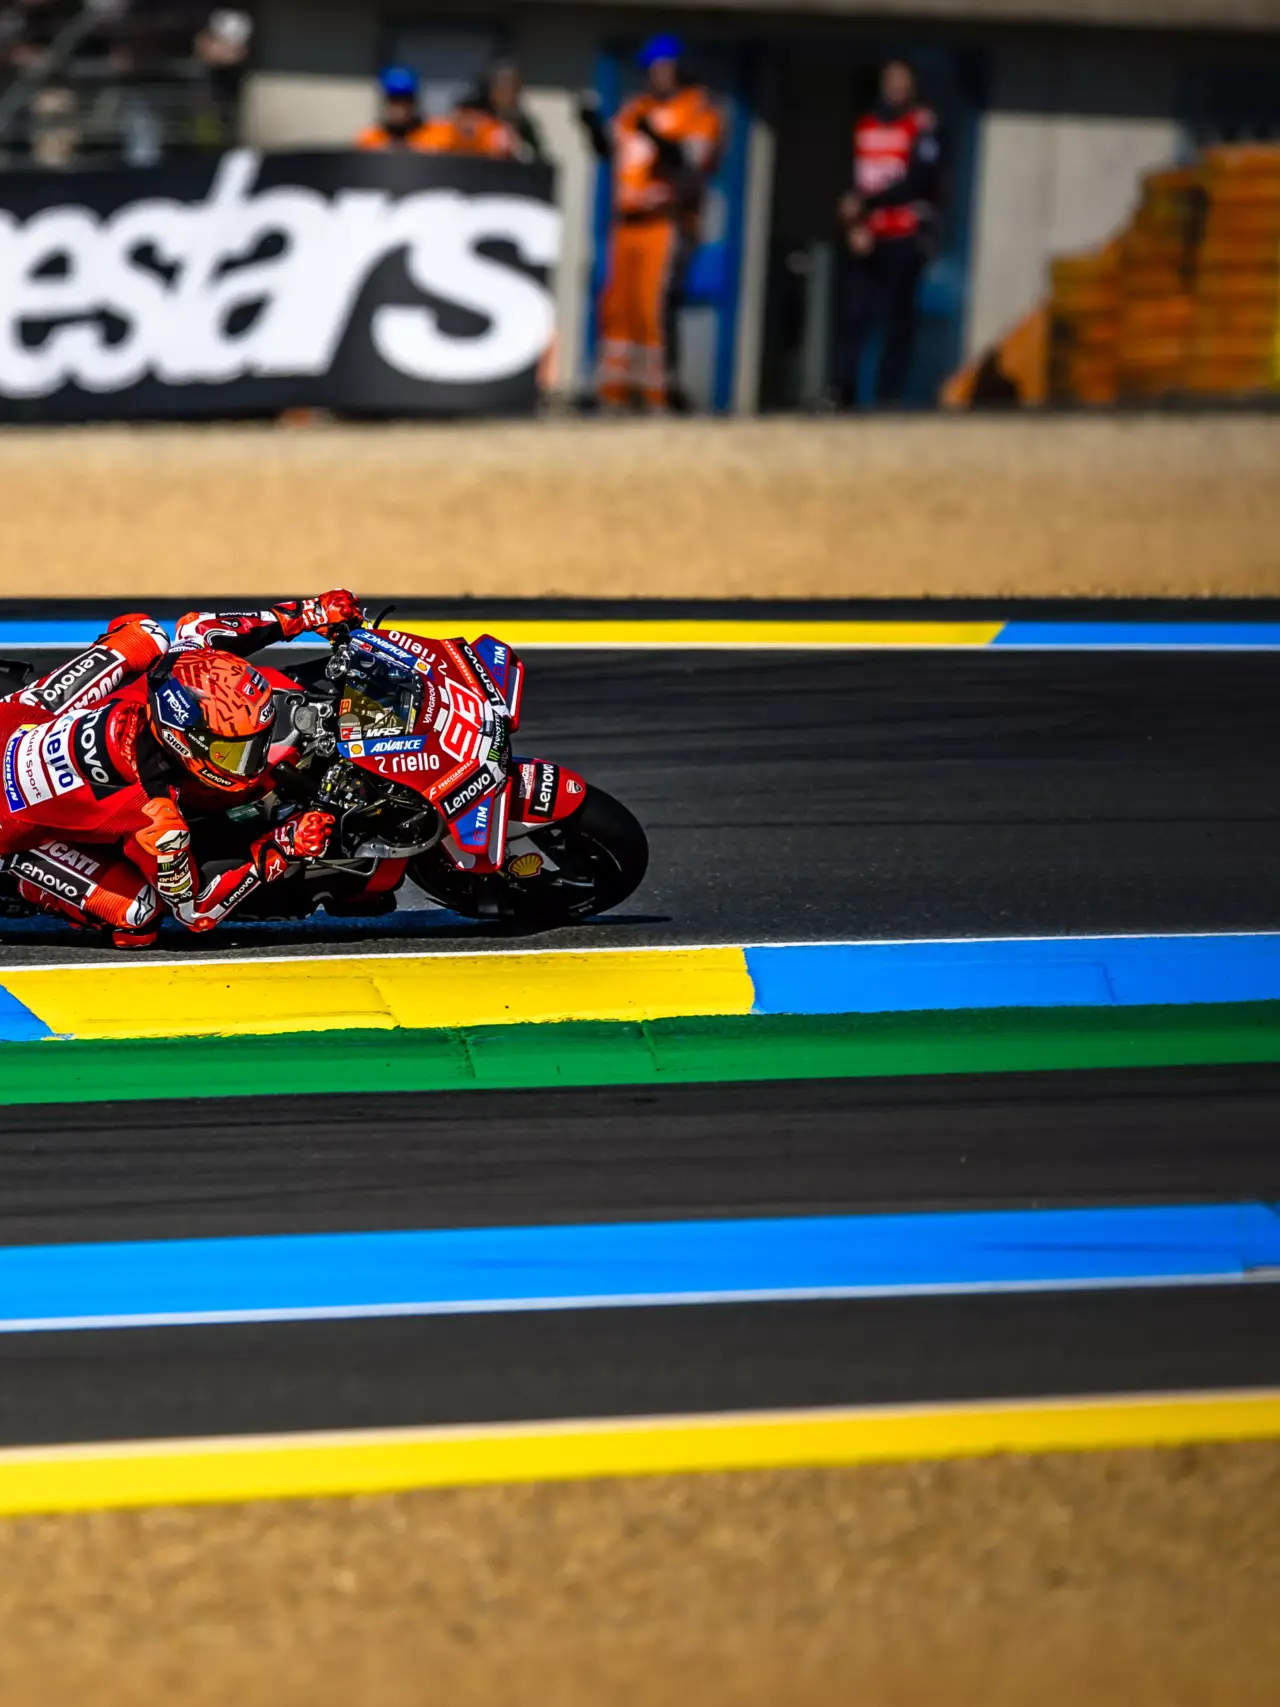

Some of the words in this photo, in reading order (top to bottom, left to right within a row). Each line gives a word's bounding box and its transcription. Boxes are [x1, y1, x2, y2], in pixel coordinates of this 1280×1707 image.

[388, 630, 437, 663] riello
[494, 645, 507, 665] TIM
[43, 652, 108, 701] Lenovo
[464, 645, 505, 706] Lenovo
[163, 689, 189, 722] next
[26, 729, 39, 757] Audi
[80, 703, 110, 784] novo
[165, 733, 189, 757] SHOEI
[365, 726, 403, 739] WRS
[370, 739, 422, 753] ADVANCE
[5, 741, 19, 801] MICHELIN
[46, 722, 74, 789] iello
[391, 752, 440, 773] riello
[25, 759, 42, 799] Sport
[202, 769, 232, 786] Lenovo
[443, 772, 491, 815] Lenovo
[475, 805, 488, 828] TIM
[39, 840, 100, 875] CATI
[10, 853, 77, 897] Lenovo
[223, 876, 254, 907] Lenovo
